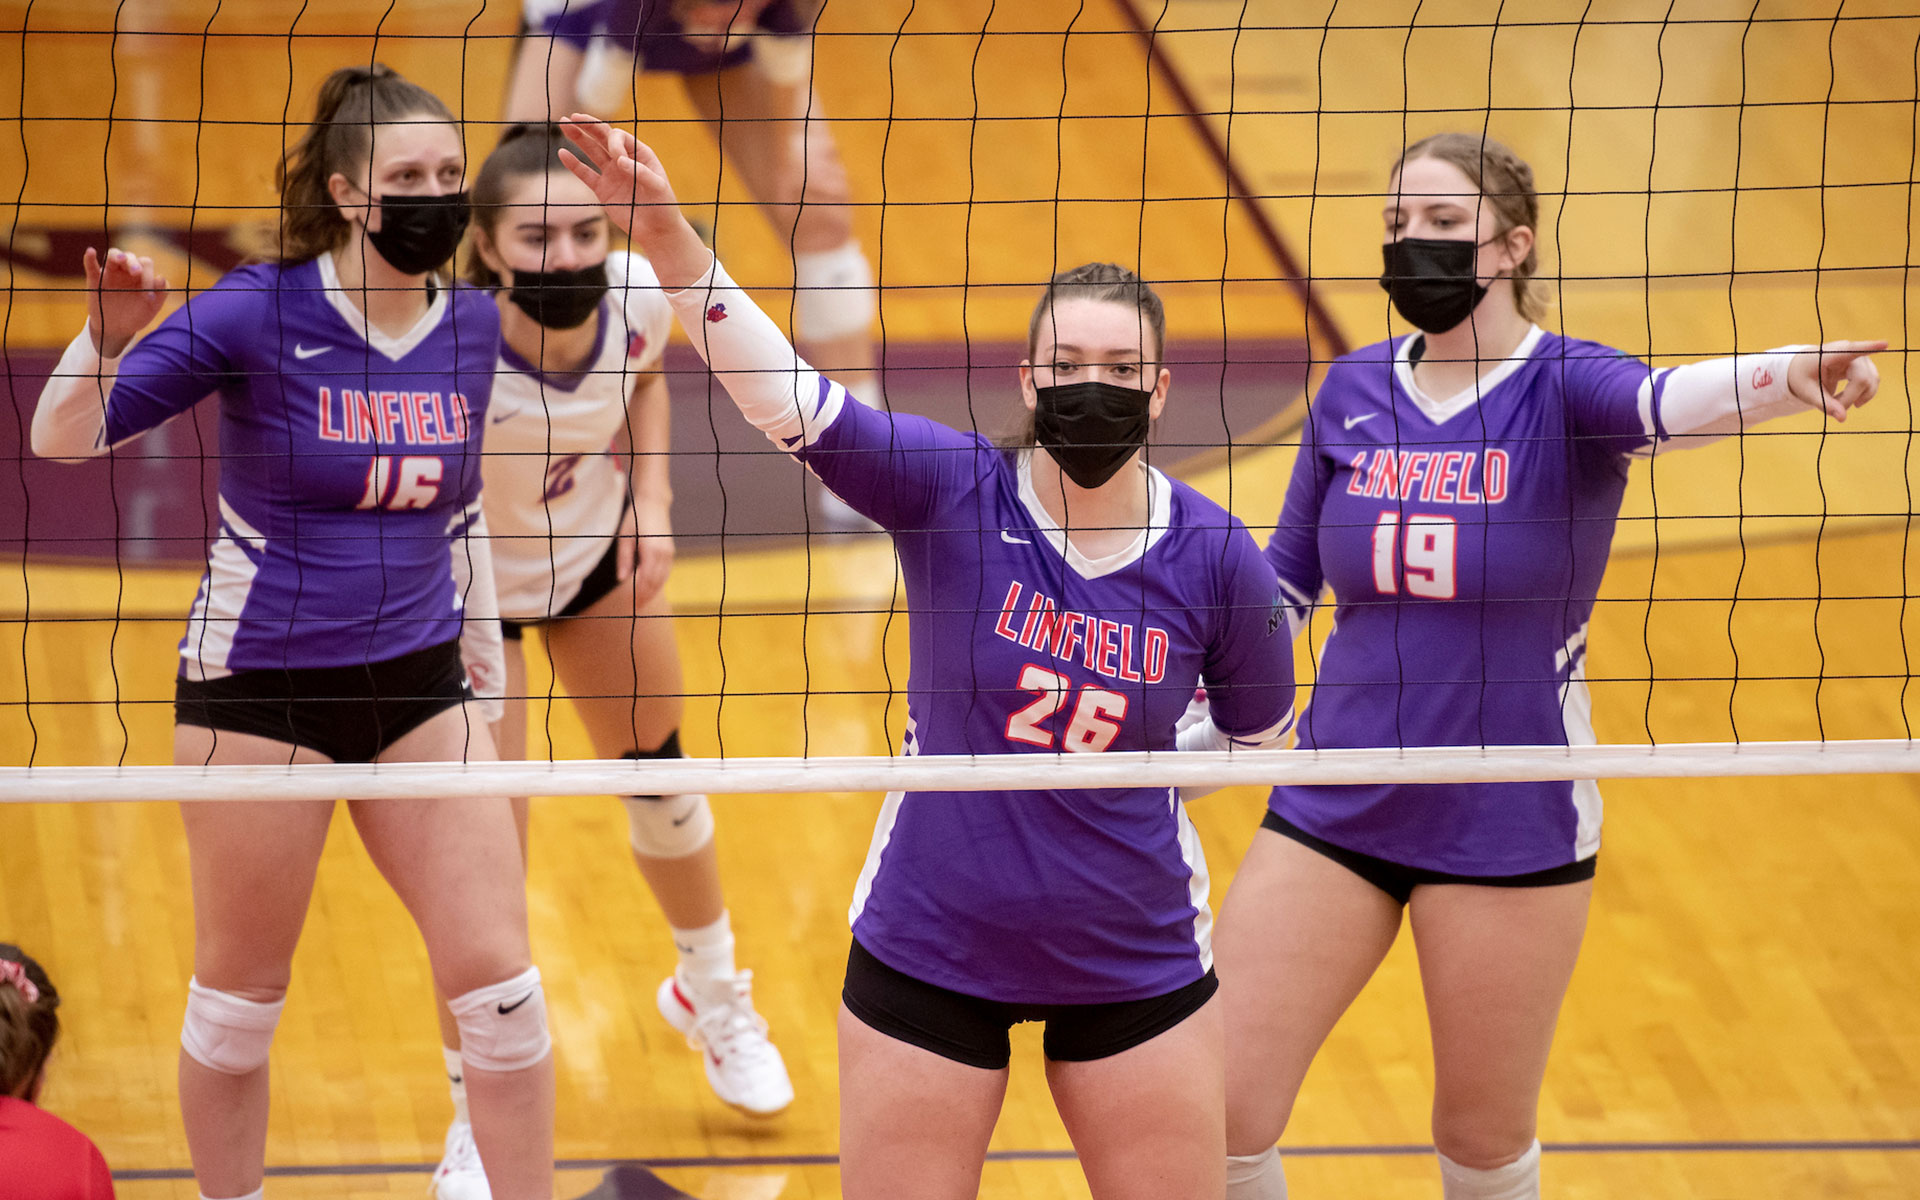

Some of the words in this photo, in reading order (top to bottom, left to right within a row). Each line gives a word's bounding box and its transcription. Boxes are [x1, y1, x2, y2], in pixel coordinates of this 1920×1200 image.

[319, 387, 470, 445] LINFIELD
[355, 456, 443, 511] 16
[537, 452, 582, 504] 2
[1346, 448, 1509, 504] LINFIELD
[1371, 510, 1458, 600] 19
[994, 580, 1169, 684] LINFIELD
[1004, 662, 1129, 752] 26
